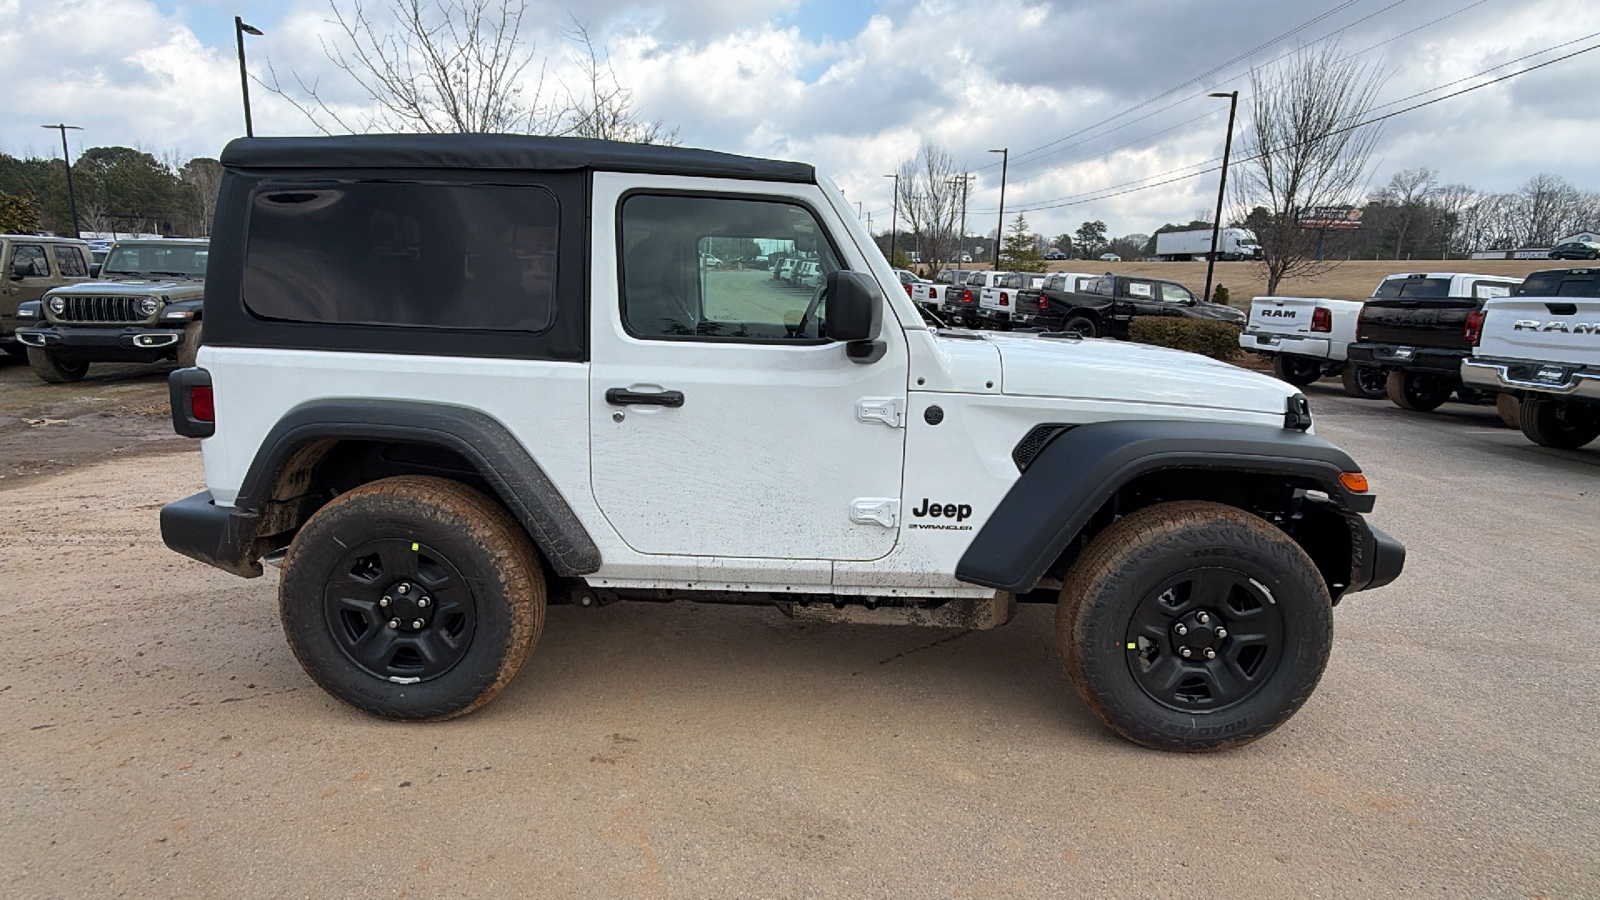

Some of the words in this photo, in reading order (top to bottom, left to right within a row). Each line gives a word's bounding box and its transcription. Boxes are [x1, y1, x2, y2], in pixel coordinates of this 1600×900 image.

[1261, 309, 1297, 318] RAM
[1514, 319, 1600, 335] RAM
[912, 498, 972, 522] Jeep
